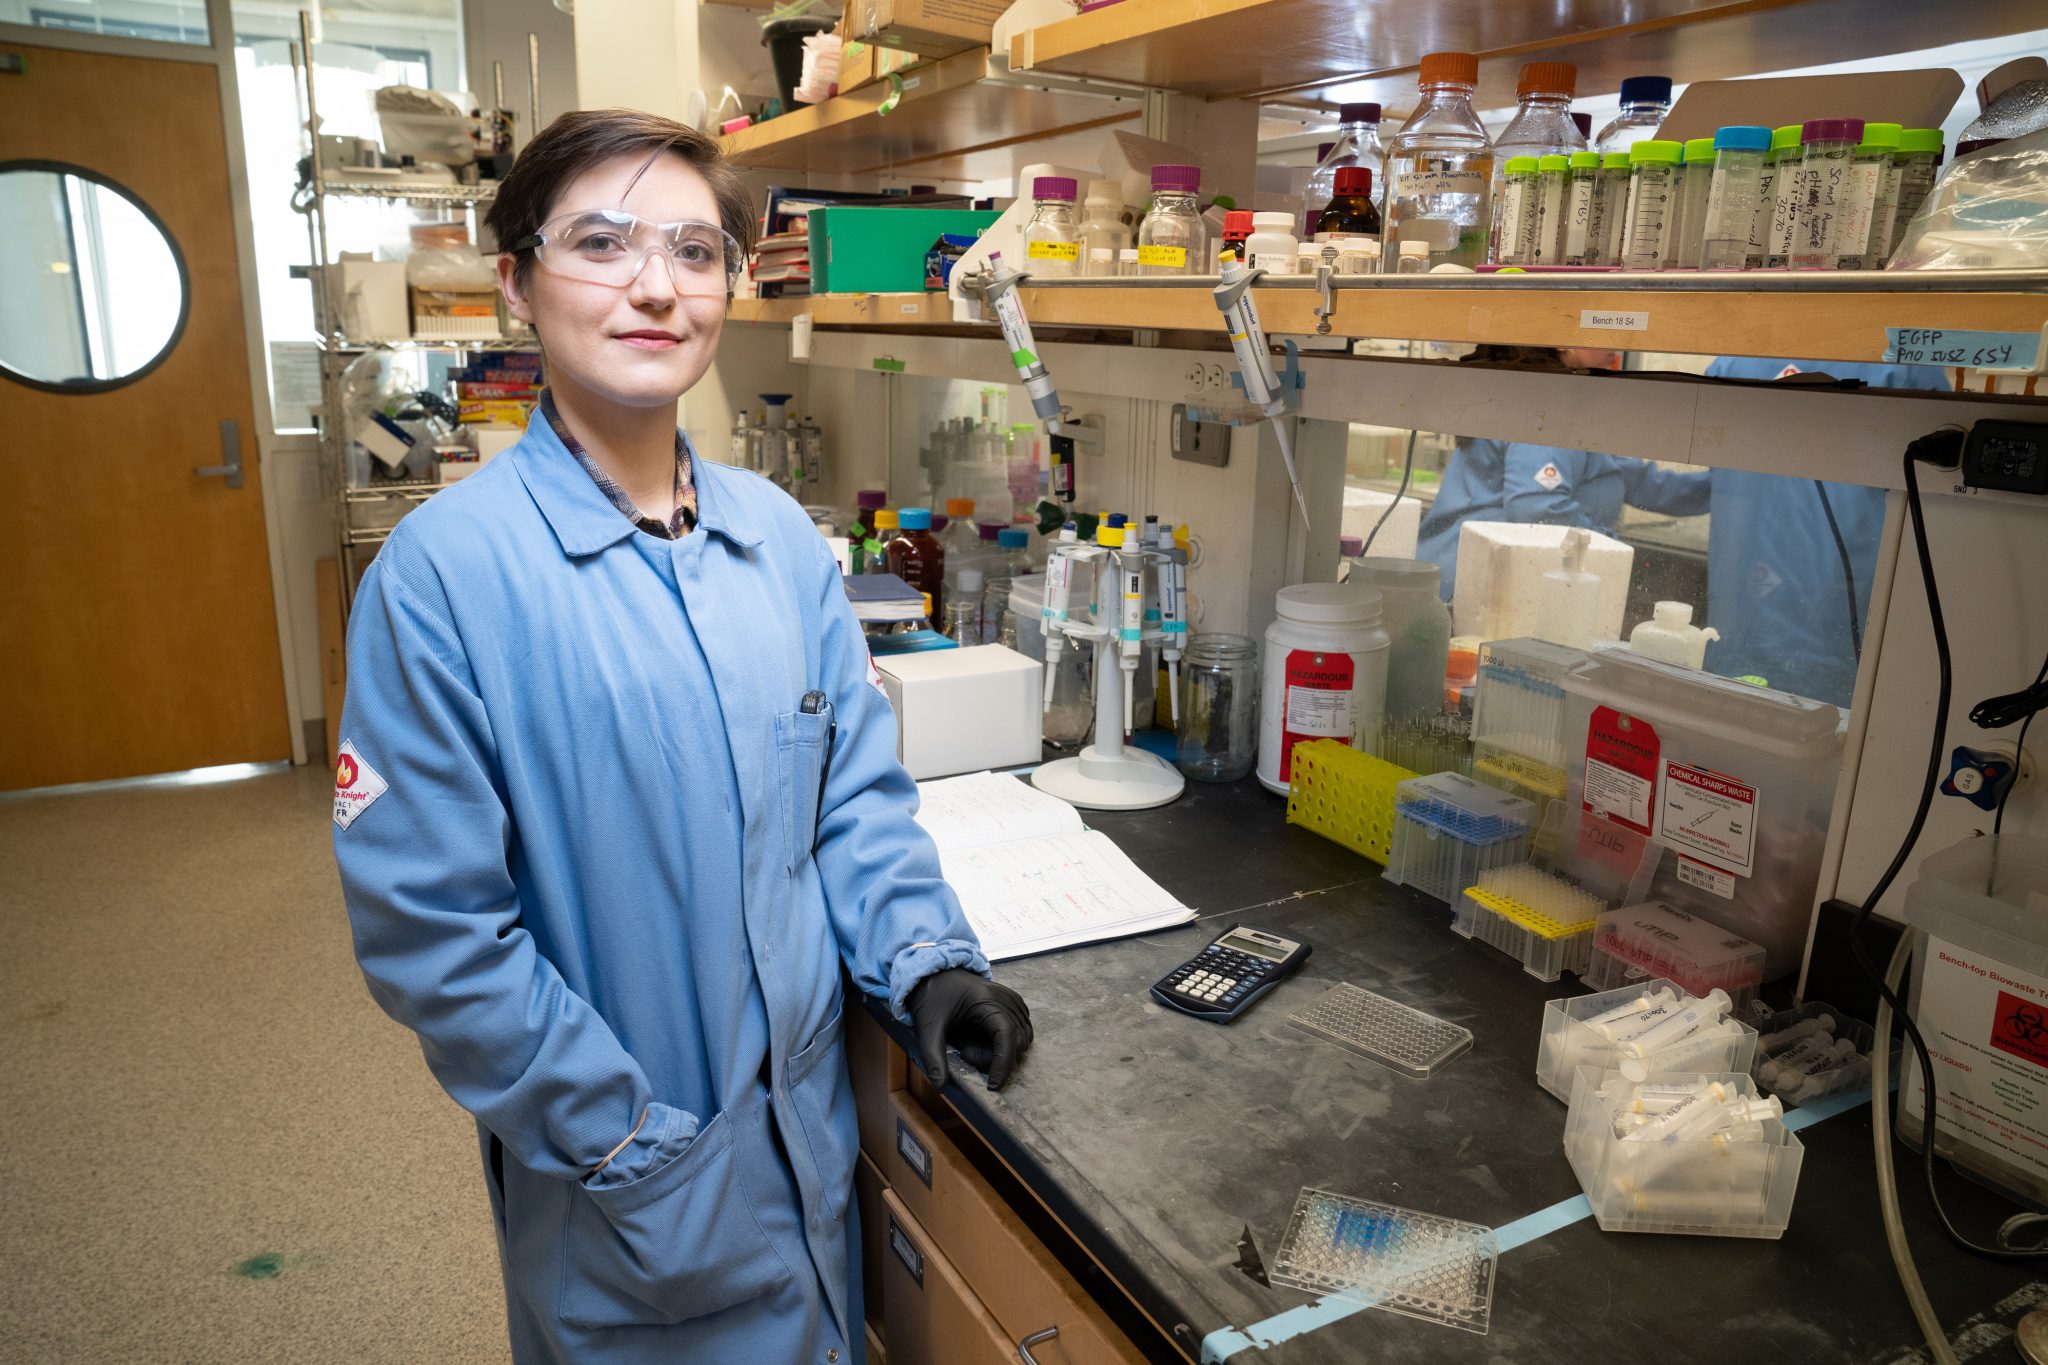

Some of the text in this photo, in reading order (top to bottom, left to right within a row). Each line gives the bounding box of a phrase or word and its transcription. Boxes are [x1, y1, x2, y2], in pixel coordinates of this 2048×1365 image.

[1243, 296, 1256, 325] eppendorf
[1592, 316, 1613, 325] Bench
[1625, 317, 1635, 326] S4
[1898, 329, 1943, 346] EGFP
[1483, 654, 1498, 665] 1000
[1289, 670, 1349, 682] HAZARDOUS
[1304, 681, 1332, 690] WASTE
[1593, 730, 1655, 760] HAZARDOUS
[1607, 747, 1636, 765] WASTE
[1669, 767, 1751, 800] CHEMICAL SHARPS WASTE
[1962, 773, 1975, 790] GAS
[1681, 784, 1702, 797] Chemically
[336, 808, 347, 817] FR
[1721, 802, 1731, 810] Skin
[1685, 827, 1709, 840] INFECTIOUS
[1709, 836, 1730, 849] MATERIALS
[1939, 951, 1987, 978] Bench-top
[1989, 971, 2035, 995] Biowaste
[1939, 1053, 1973, 1073] LIQUIDS!
[1940, 1030, 1958, 1042] Please
[1958, 1039, 1968, 1047] use
[1968, 1040, 1979, 1051] this
[1979, 1048, 2009, 1063] container
[2013, 1061, 2033, 1074] collect
[2033, 1069, 2044, 1079] the
[1990, 1060, 2028, 1079] contaminated
[1991, 1081, 2040, 1106] Eppendorf Tubes
[2020, 1085, 2034, 1096] Tips
[1949, 1090, 1964, 1101] When
[1976, 1103, 1994, 1116] please
[2002, 1100, 2023, 1113] Gloves
[2015, 1099, 2033, 1111] Tubes
